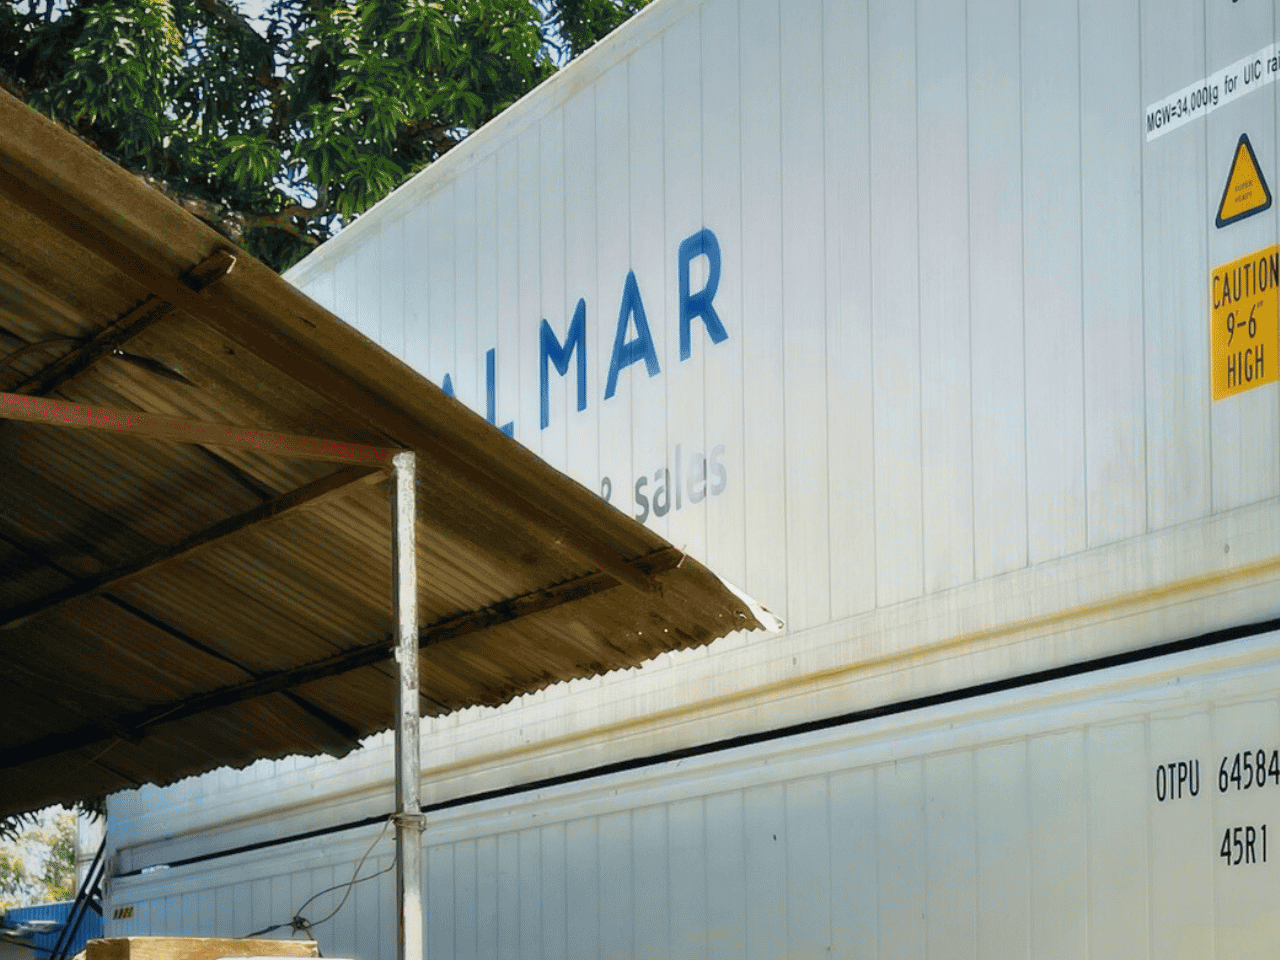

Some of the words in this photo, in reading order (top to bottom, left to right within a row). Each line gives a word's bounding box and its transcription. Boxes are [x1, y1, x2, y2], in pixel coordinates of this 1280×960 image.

[1224, 74, 1238, 95] for
[1243, 60, 1262, 85] UIC
[1212, 252, 1280, 310] CAUTION
[442, 226, 730, 439] LMAR
[1227, 343, 1264, 389] HIGH
[634, 443, 728, 525] sales
[1156, 758, 1200, 802] OTPU
[1220, 824, 1267, 866] 45R1
